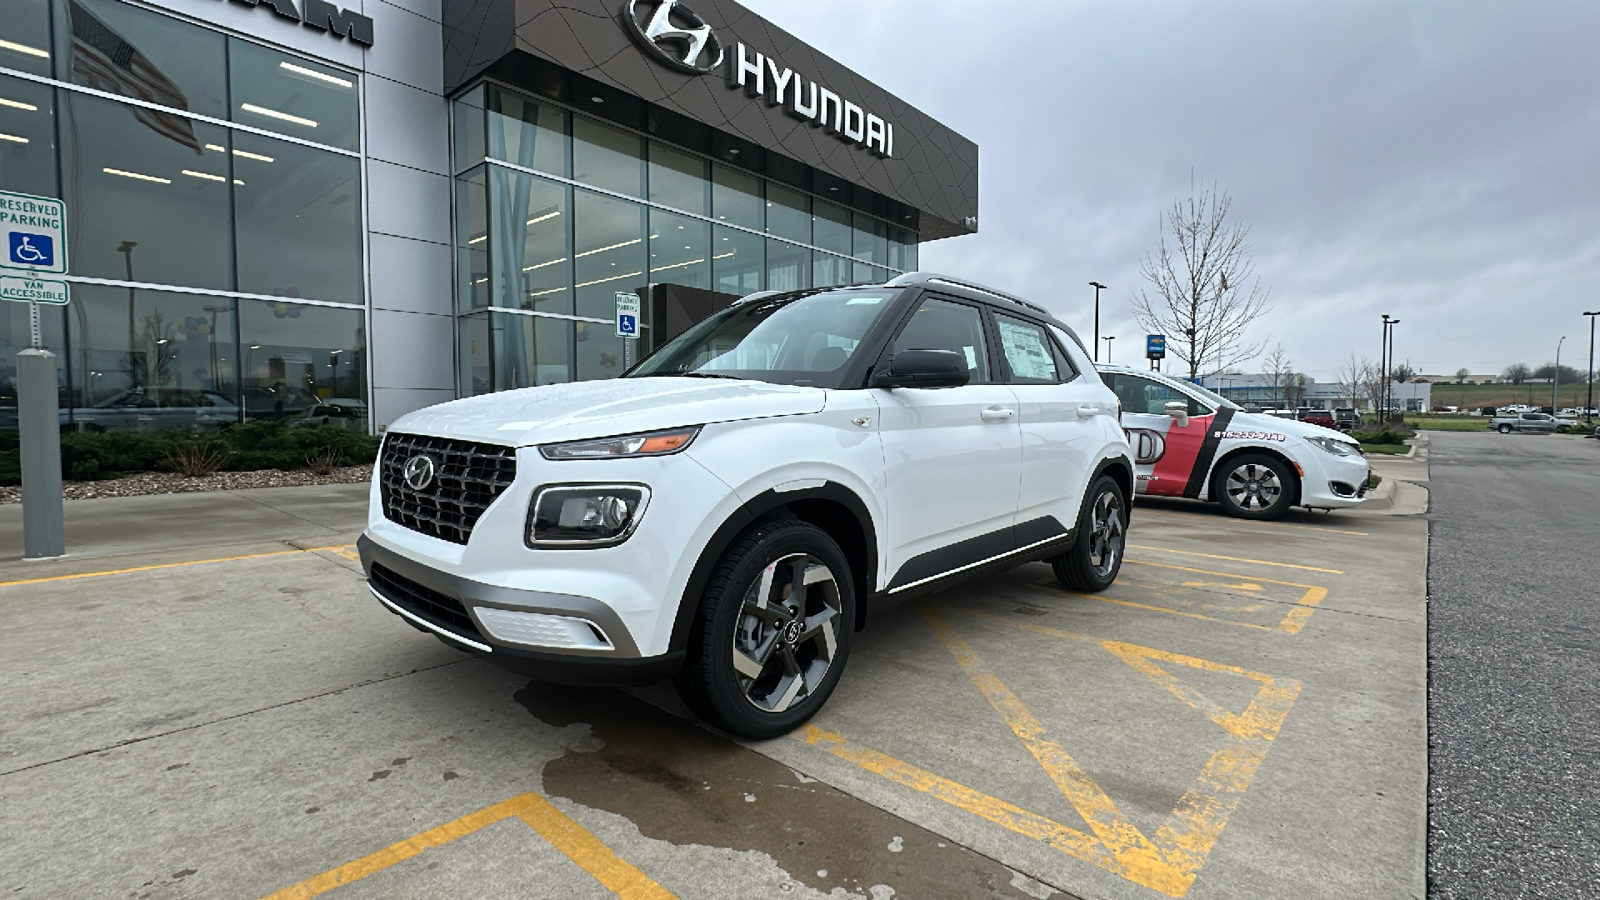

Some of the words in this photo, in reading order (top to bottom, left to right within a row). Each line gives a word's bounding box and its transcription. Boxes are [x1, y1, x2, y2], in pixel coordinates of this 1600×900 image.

[733, 41, 893, 158] HYUNDAI
[0, 199, 58, 216] RESERVED
[0, 212, 60, 229] PARKING
[2, 287, 65, 301] ACCESSIBLE
[24, 281, 44, 290] VAN
